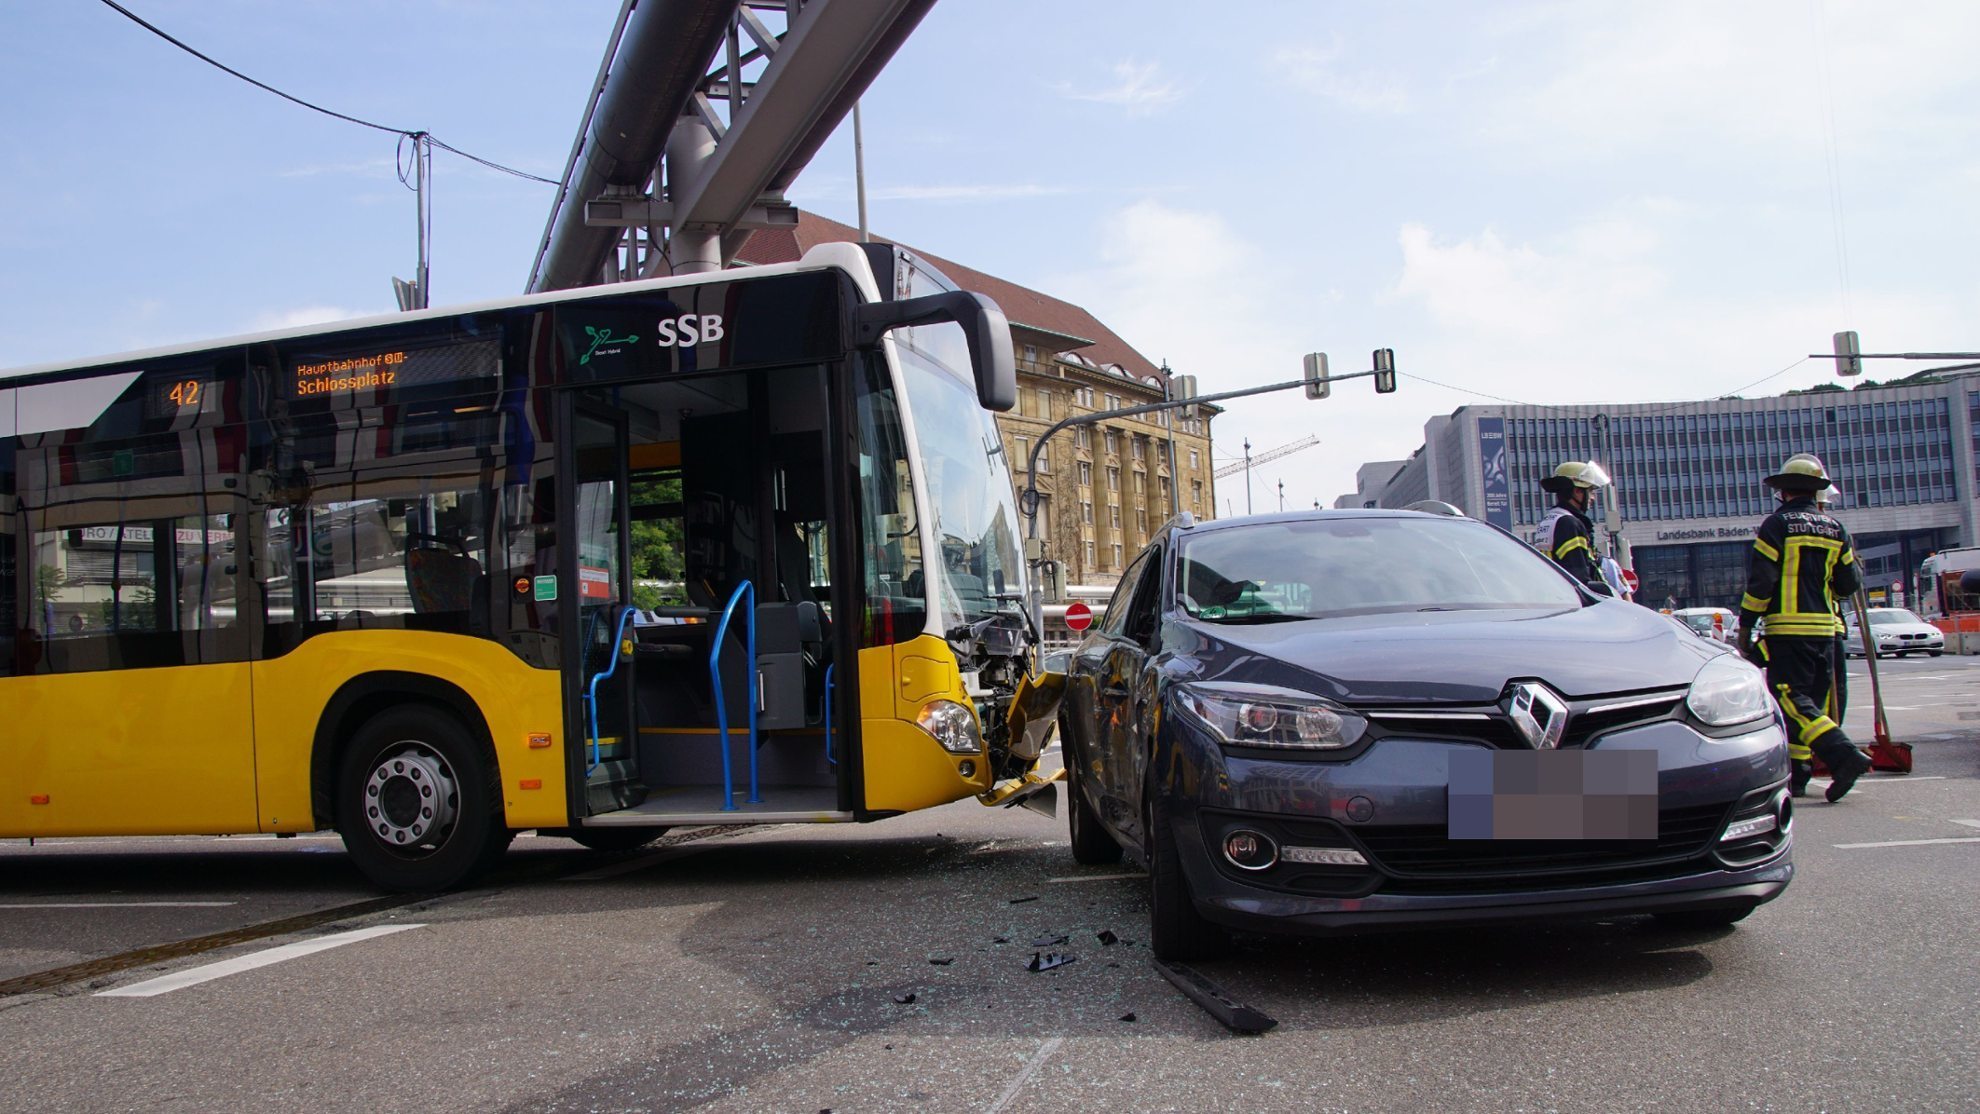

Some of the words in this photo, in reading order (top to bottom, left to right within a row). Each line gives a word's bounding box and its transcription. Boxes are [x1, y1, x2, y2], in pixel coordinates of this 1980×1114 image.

[658, 314, 724, 347] SSB
[297, 355, 382, 376] Hauptbahnhof
[169, 380, 198, 406] 42
[297, 371, 395, 395] Schlossplatz
[1657, 528, 1715, 540] Landesbank
